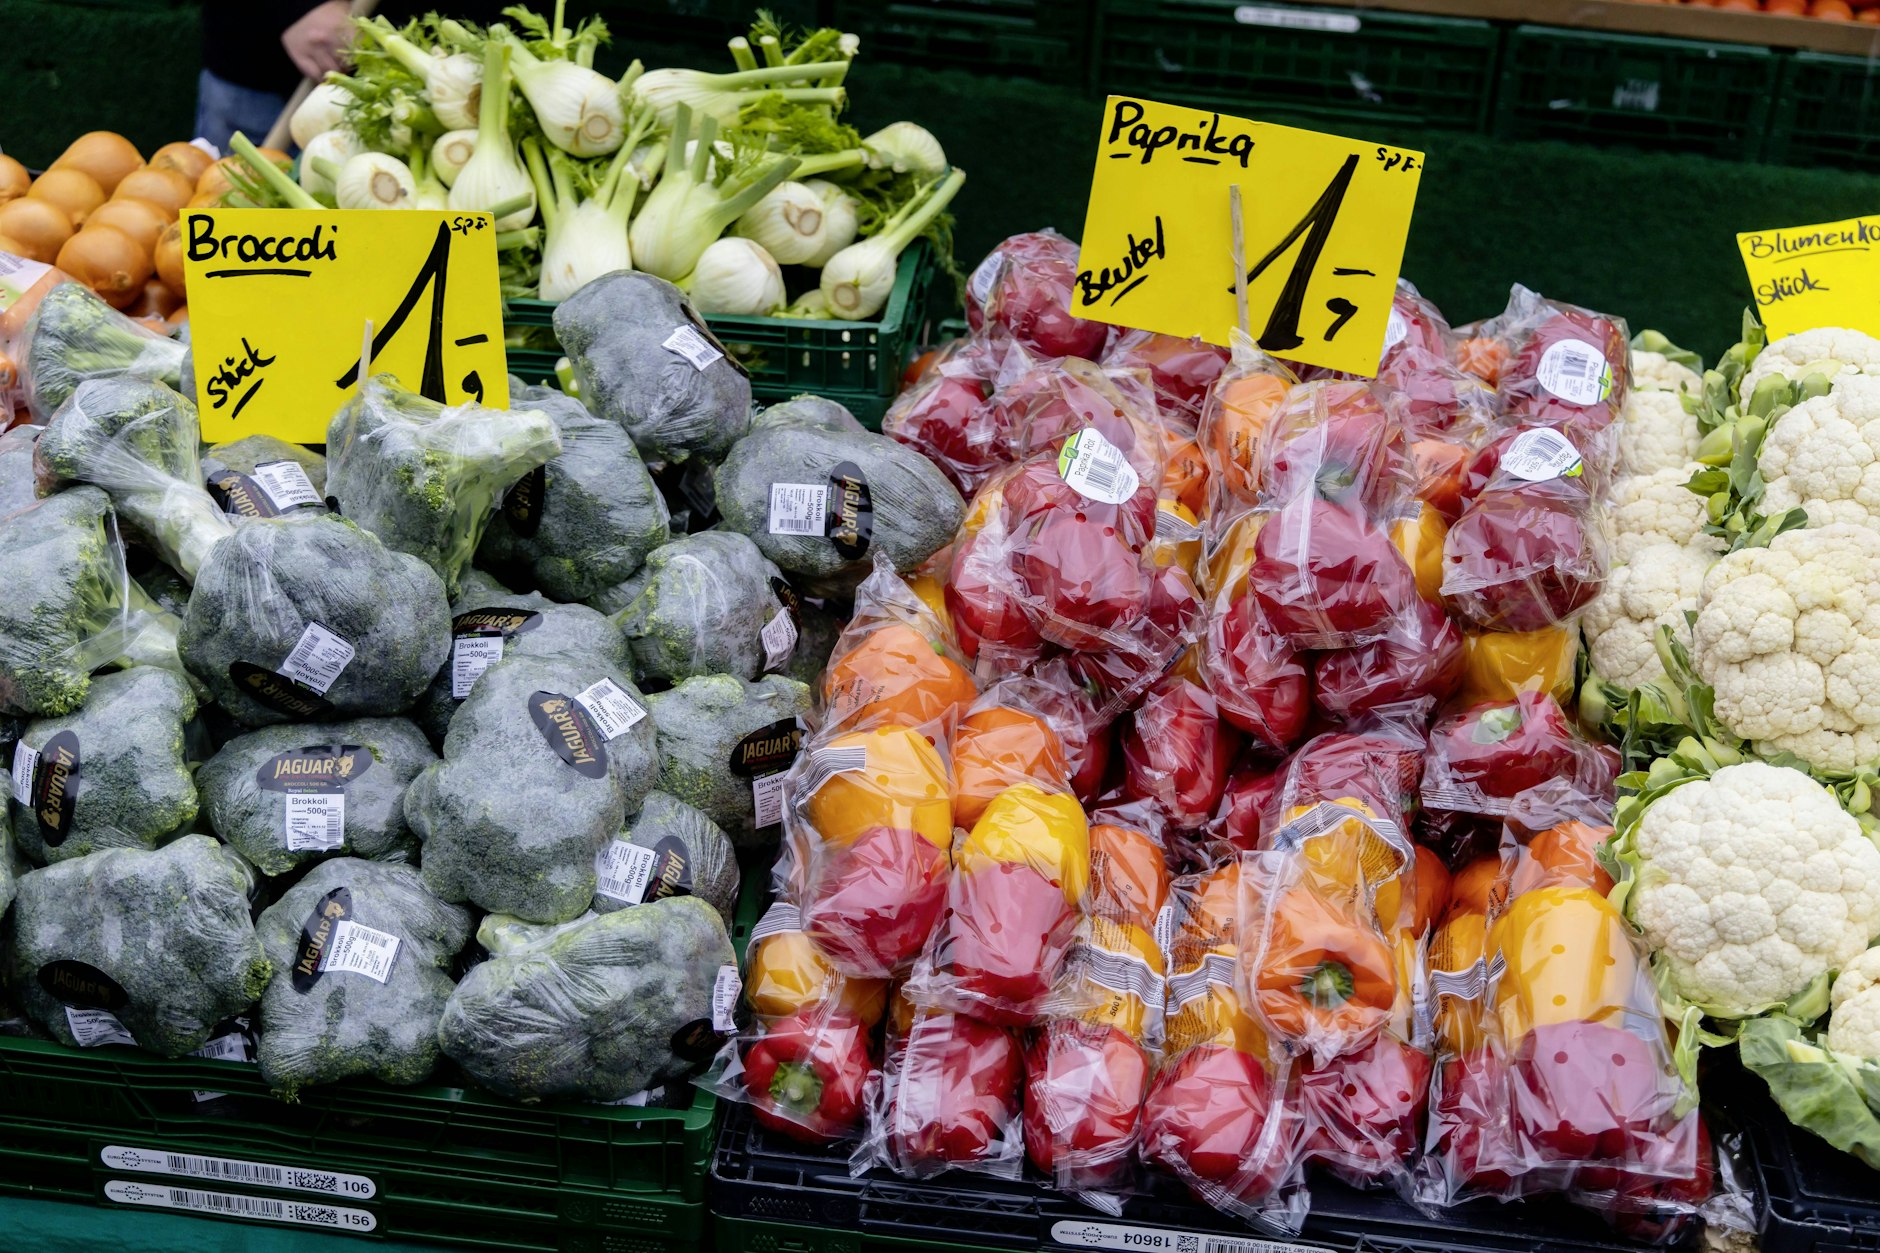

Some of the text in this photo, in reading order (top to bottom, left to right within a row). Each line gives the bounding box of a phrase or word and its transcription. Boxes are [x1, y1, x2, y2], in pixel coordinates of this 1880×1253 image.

[1108, 101, 1255, 168] Paprika
[187, 214, 338, 263] Broccoli
[1075, 215, 1165, 306] Beutel
[815, 489, 824, 522] Brokkoli
[842, 474, 862, 527] JAGUAR
[804, 502, 814, 520] 500g
[453, 614, 508, 631] JAGUAR
[458, 641, 489, 650] Brokkoli
[469, 650, 488, 660] 500g
[295, 669, 327, 688] Brokkoli
[301, 662, 320, 676] 500g
[588, 703, 614, 734] Brokkoli
[596, 700, 611, 718] 500g
[554, 710, 596, 764] JAGUAR
[742, 734, 791, 765] JAGUAR
[47, 746, 75, 809] JAGUAR
[274, 759, 335, 780] JAGUAR
[291, 797, 328, 805] Brokkoli
[306, 807, 327, 816] 500g
[624, 864, 638, 884] 500g
[634, 853, 651, 888] Brokkoli
[656, 849, 686, 899] JAGUA
[298, 920, 331, 976] JAGUAR
[330, 935, 346, 967] Brokkoli
[343, 936, 357, 954] 500g
[342, 1180, 370, 1194] 106
[342, 1214, 370, 1226] 156
[1123, 1232, 1172, 1248] 18604
